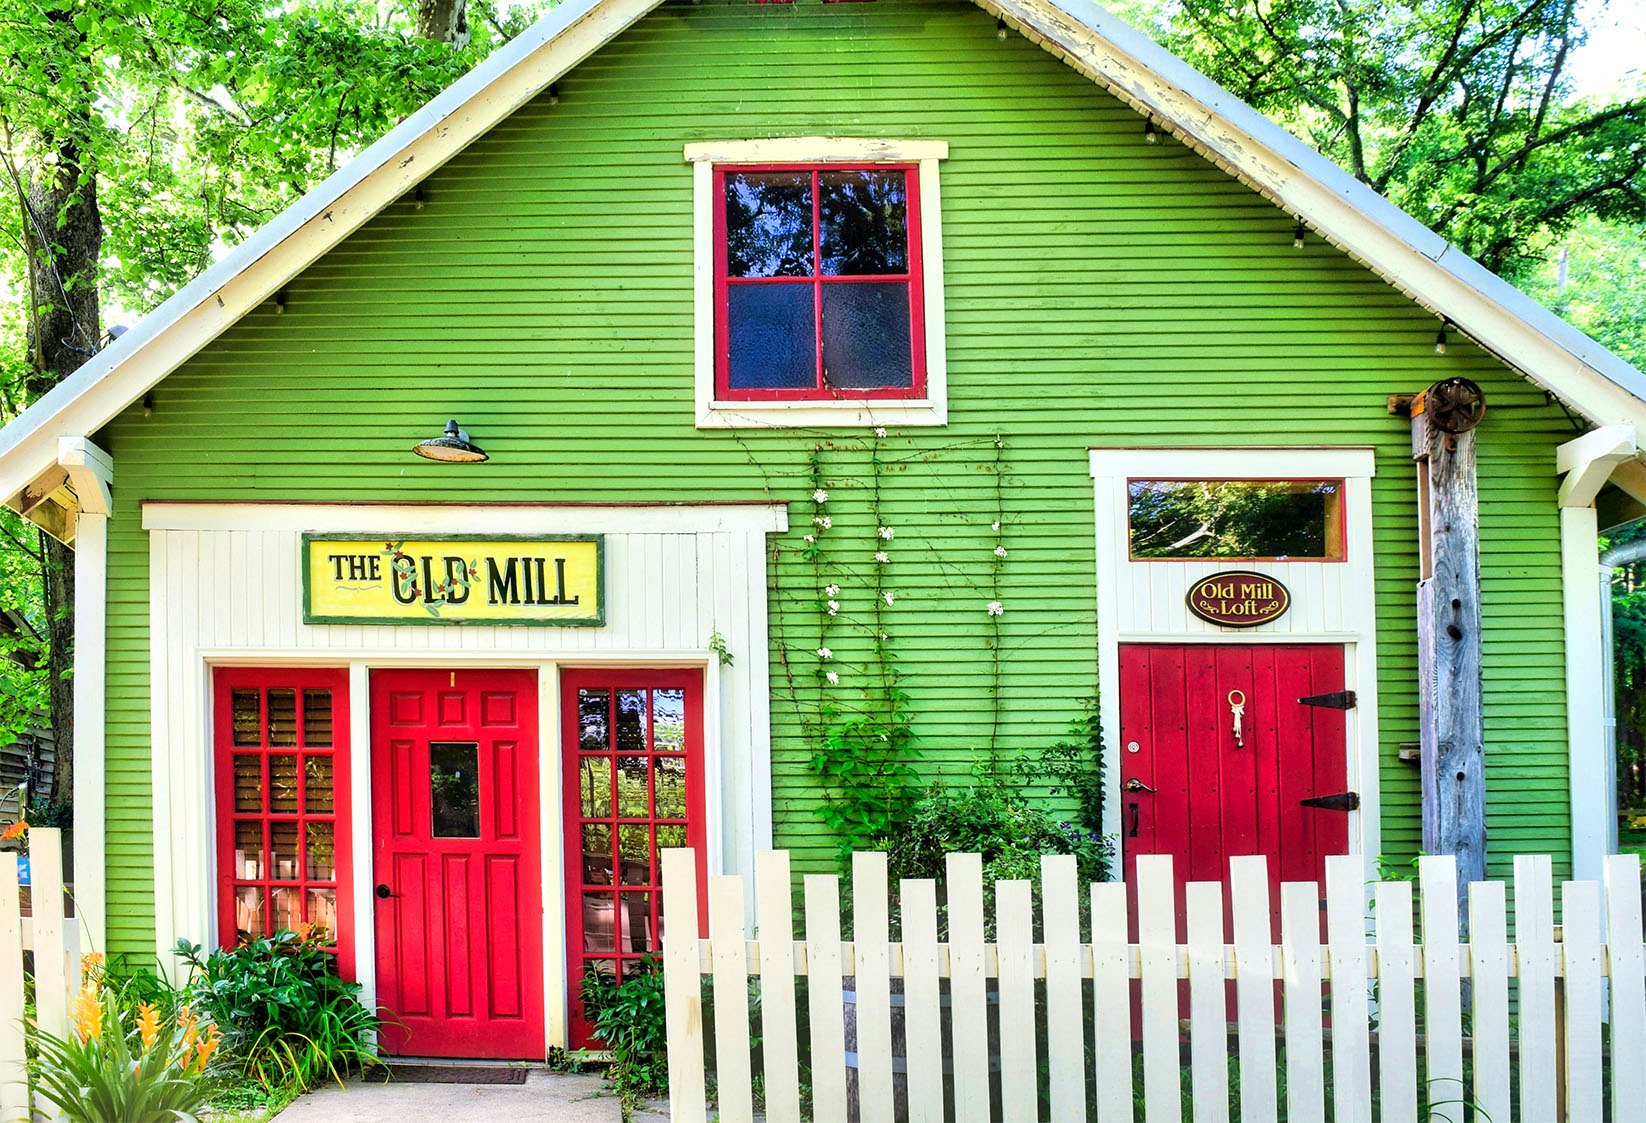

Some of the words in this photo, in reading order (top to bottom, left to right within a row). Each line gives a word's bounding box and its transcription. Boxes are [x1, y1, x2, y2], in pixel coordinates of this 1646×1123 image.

[328, 554, 382, 581] THE
[391, 555, 470, 606] OLD
[485, 557, 579, 606] MILL
[1201, 583, 1234, 599] Old
[1241, 583, 1273, 599] Mill
[1221, 600, 1258, 615] Loft
